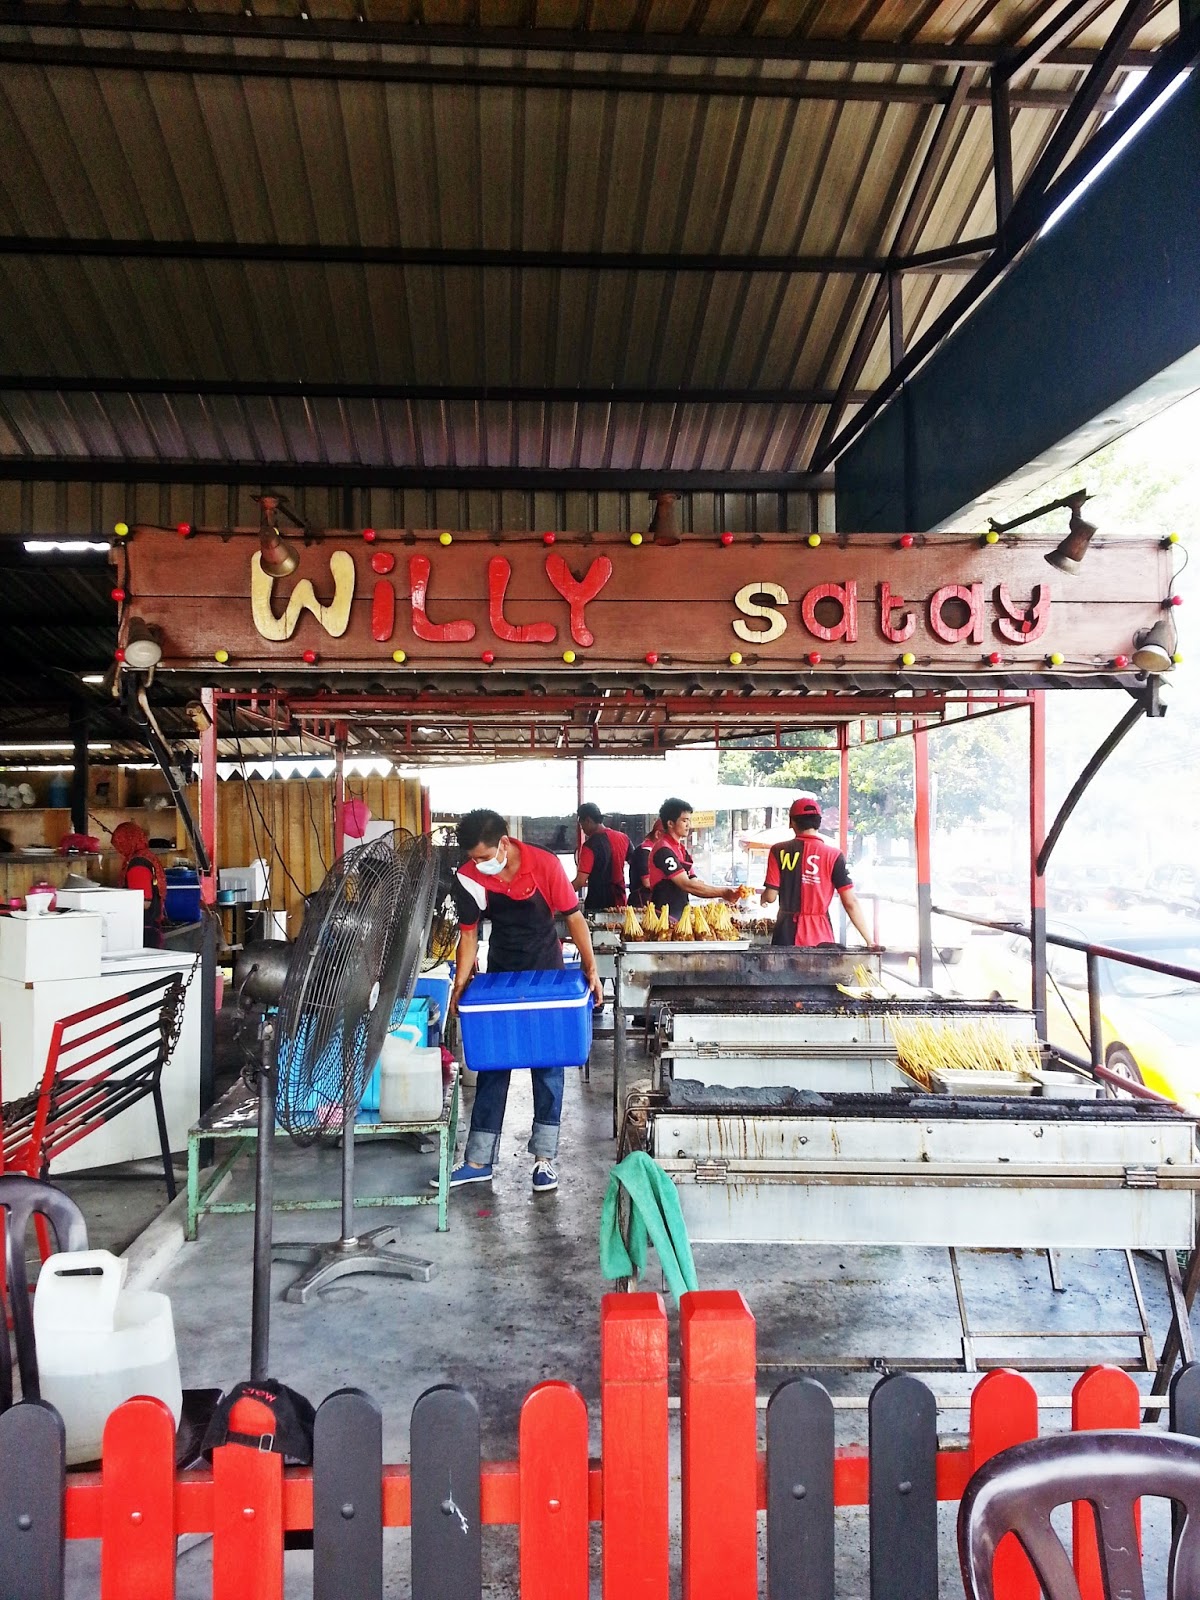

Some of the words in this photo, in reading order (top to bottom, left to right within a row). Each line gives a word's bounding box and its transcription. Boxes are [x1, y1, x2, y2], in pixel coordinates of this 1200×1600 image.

[251, 550, 613, 647] WiLLY
[732, 581, 1052, 644] satay
[665, 857, 678, 871] 3
[780, 849, 800, 871] W
[805, 854, 820, 875] S
